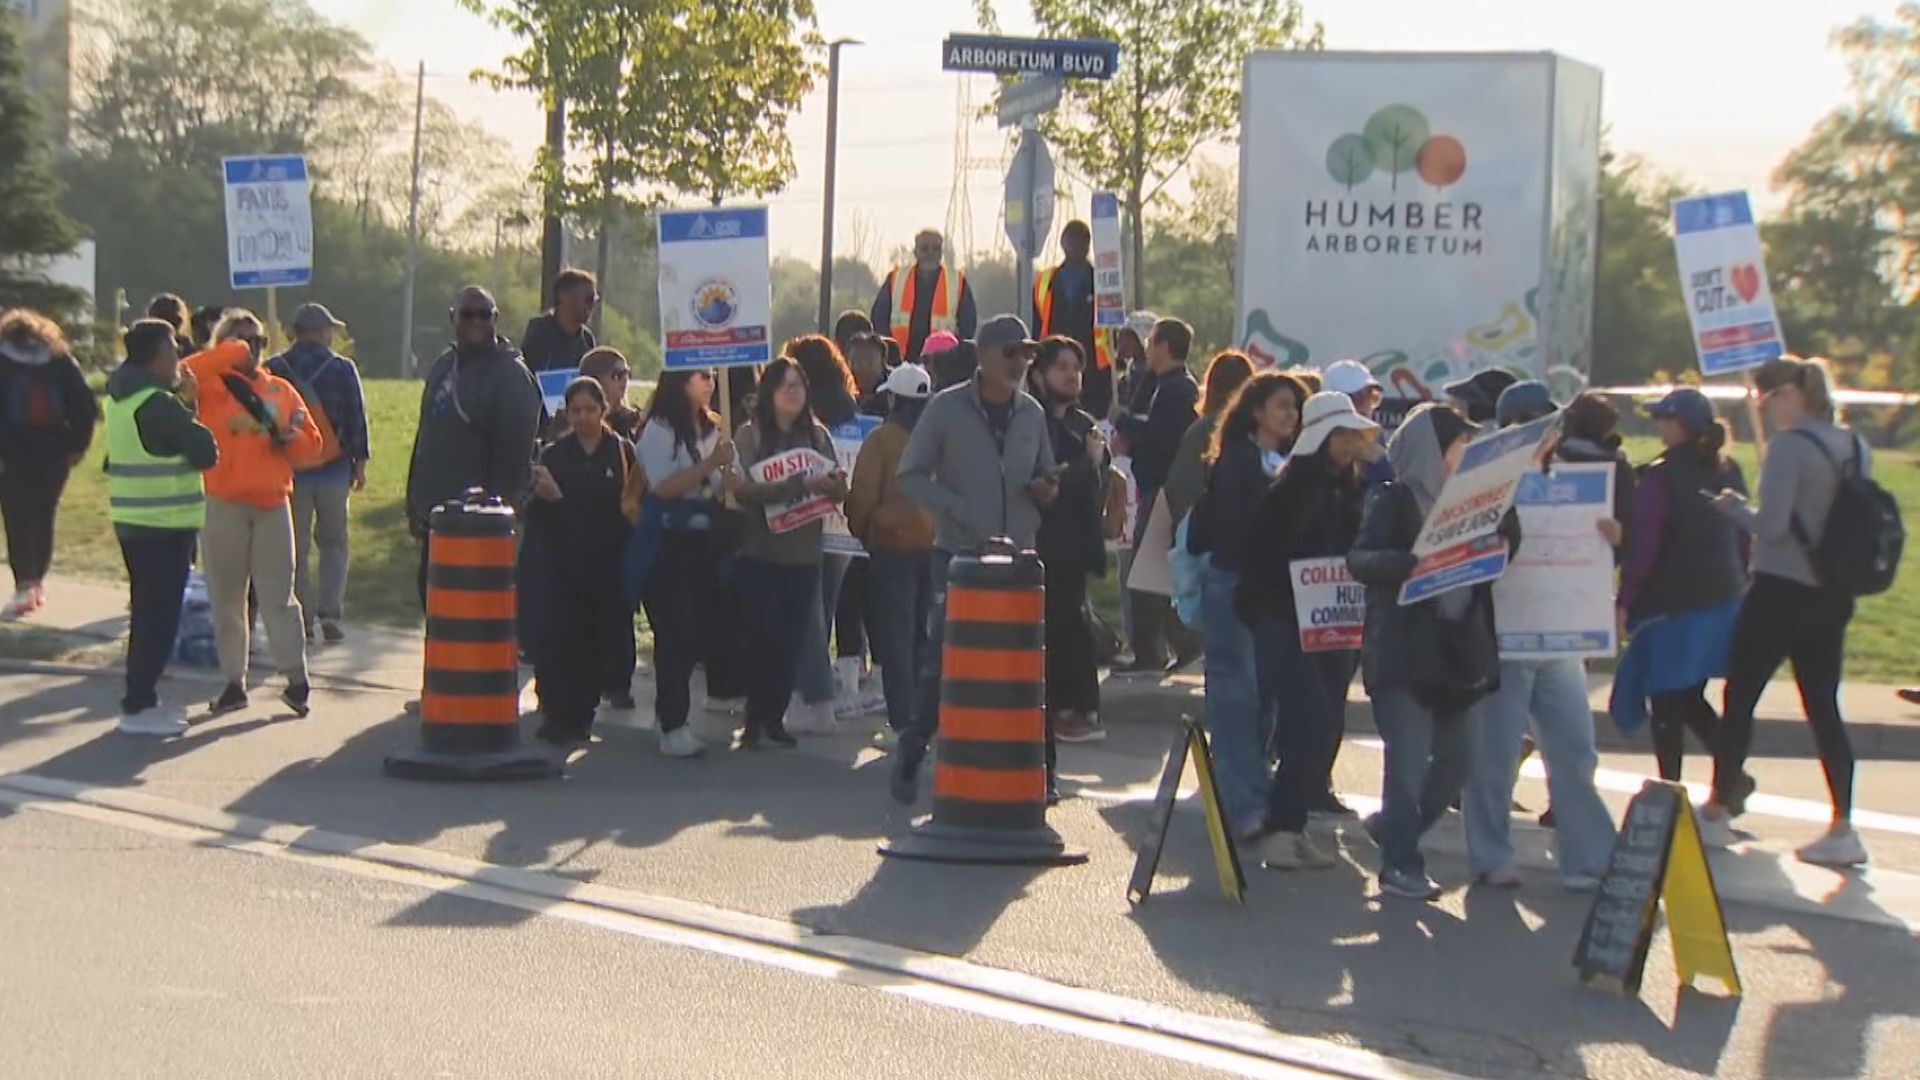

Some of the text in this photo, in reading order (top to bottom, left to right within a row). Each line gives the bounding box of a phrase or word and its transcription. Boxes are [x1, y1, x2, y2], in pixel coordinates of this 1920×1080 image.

[950, 47, 1104, 73] ARBORETUM BLVD
[1305, 200, 1483, 230] HUMBER
[1306, 234, 1483, 255] ARBORETUM
[1694, 286, 1725, 314] CUT
[763, 460, 785, 481] ON
[1301, 566, 1351, 586] COLLE
